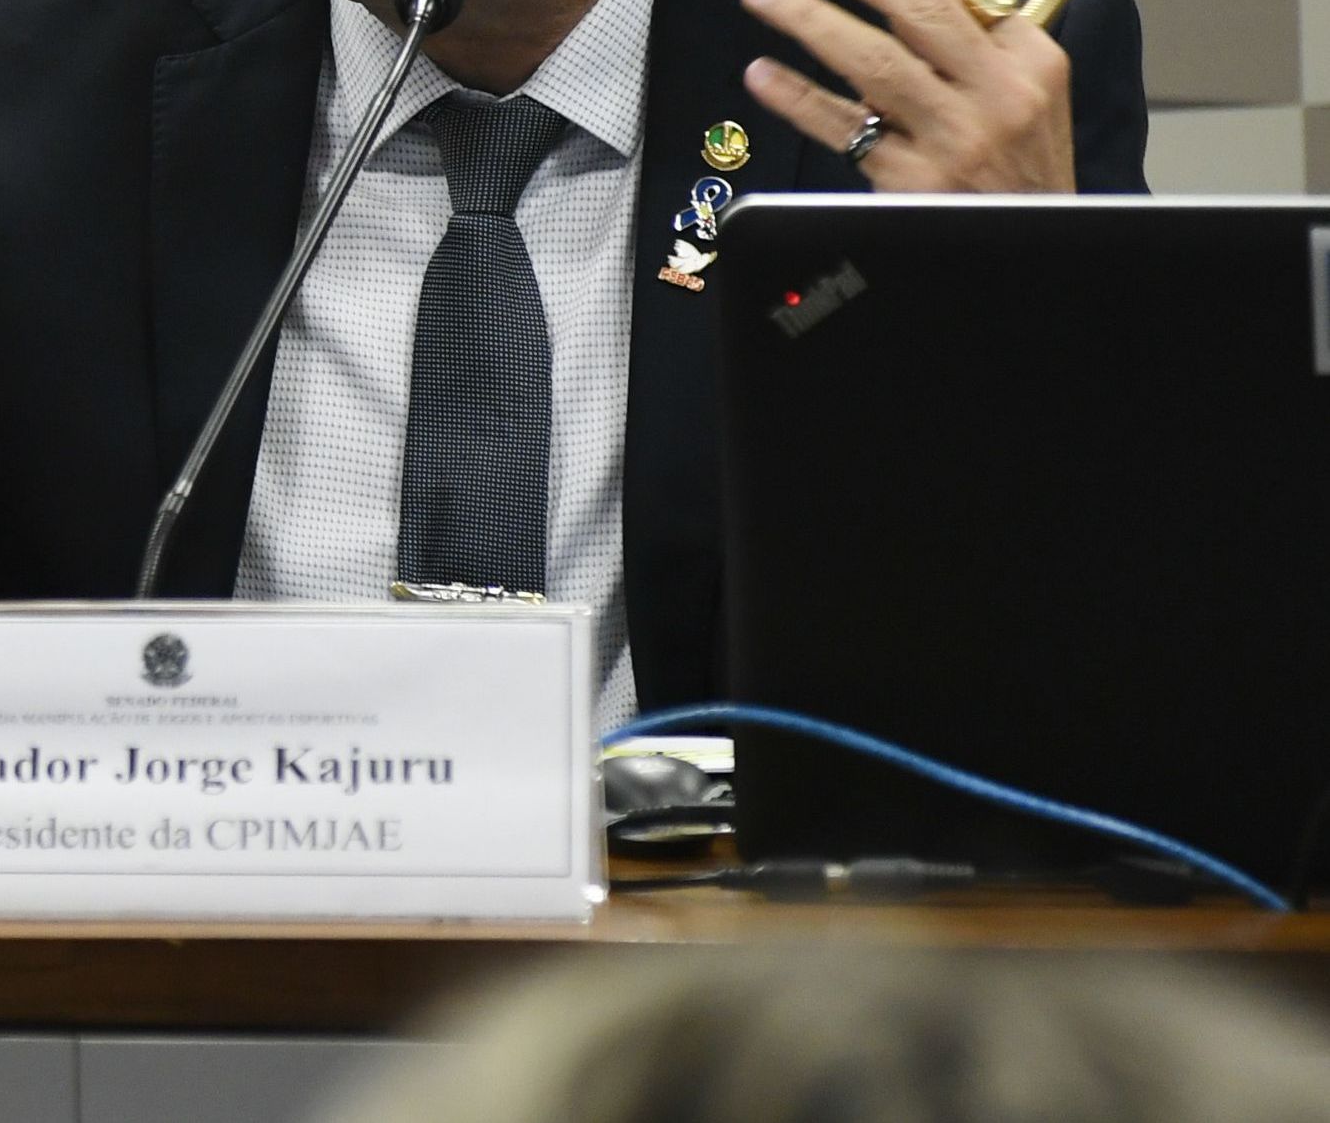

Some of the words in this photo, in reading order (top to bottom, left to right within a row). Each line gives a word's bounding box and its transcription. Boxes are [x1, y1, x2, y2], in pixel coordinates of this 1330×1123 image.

[115, 747, 254, 795] Jorge
[274, 747, 454, 795] Kajuru
[149, 818, 192, 850] da
[206, 818, 403, 852] CPIMJAE
